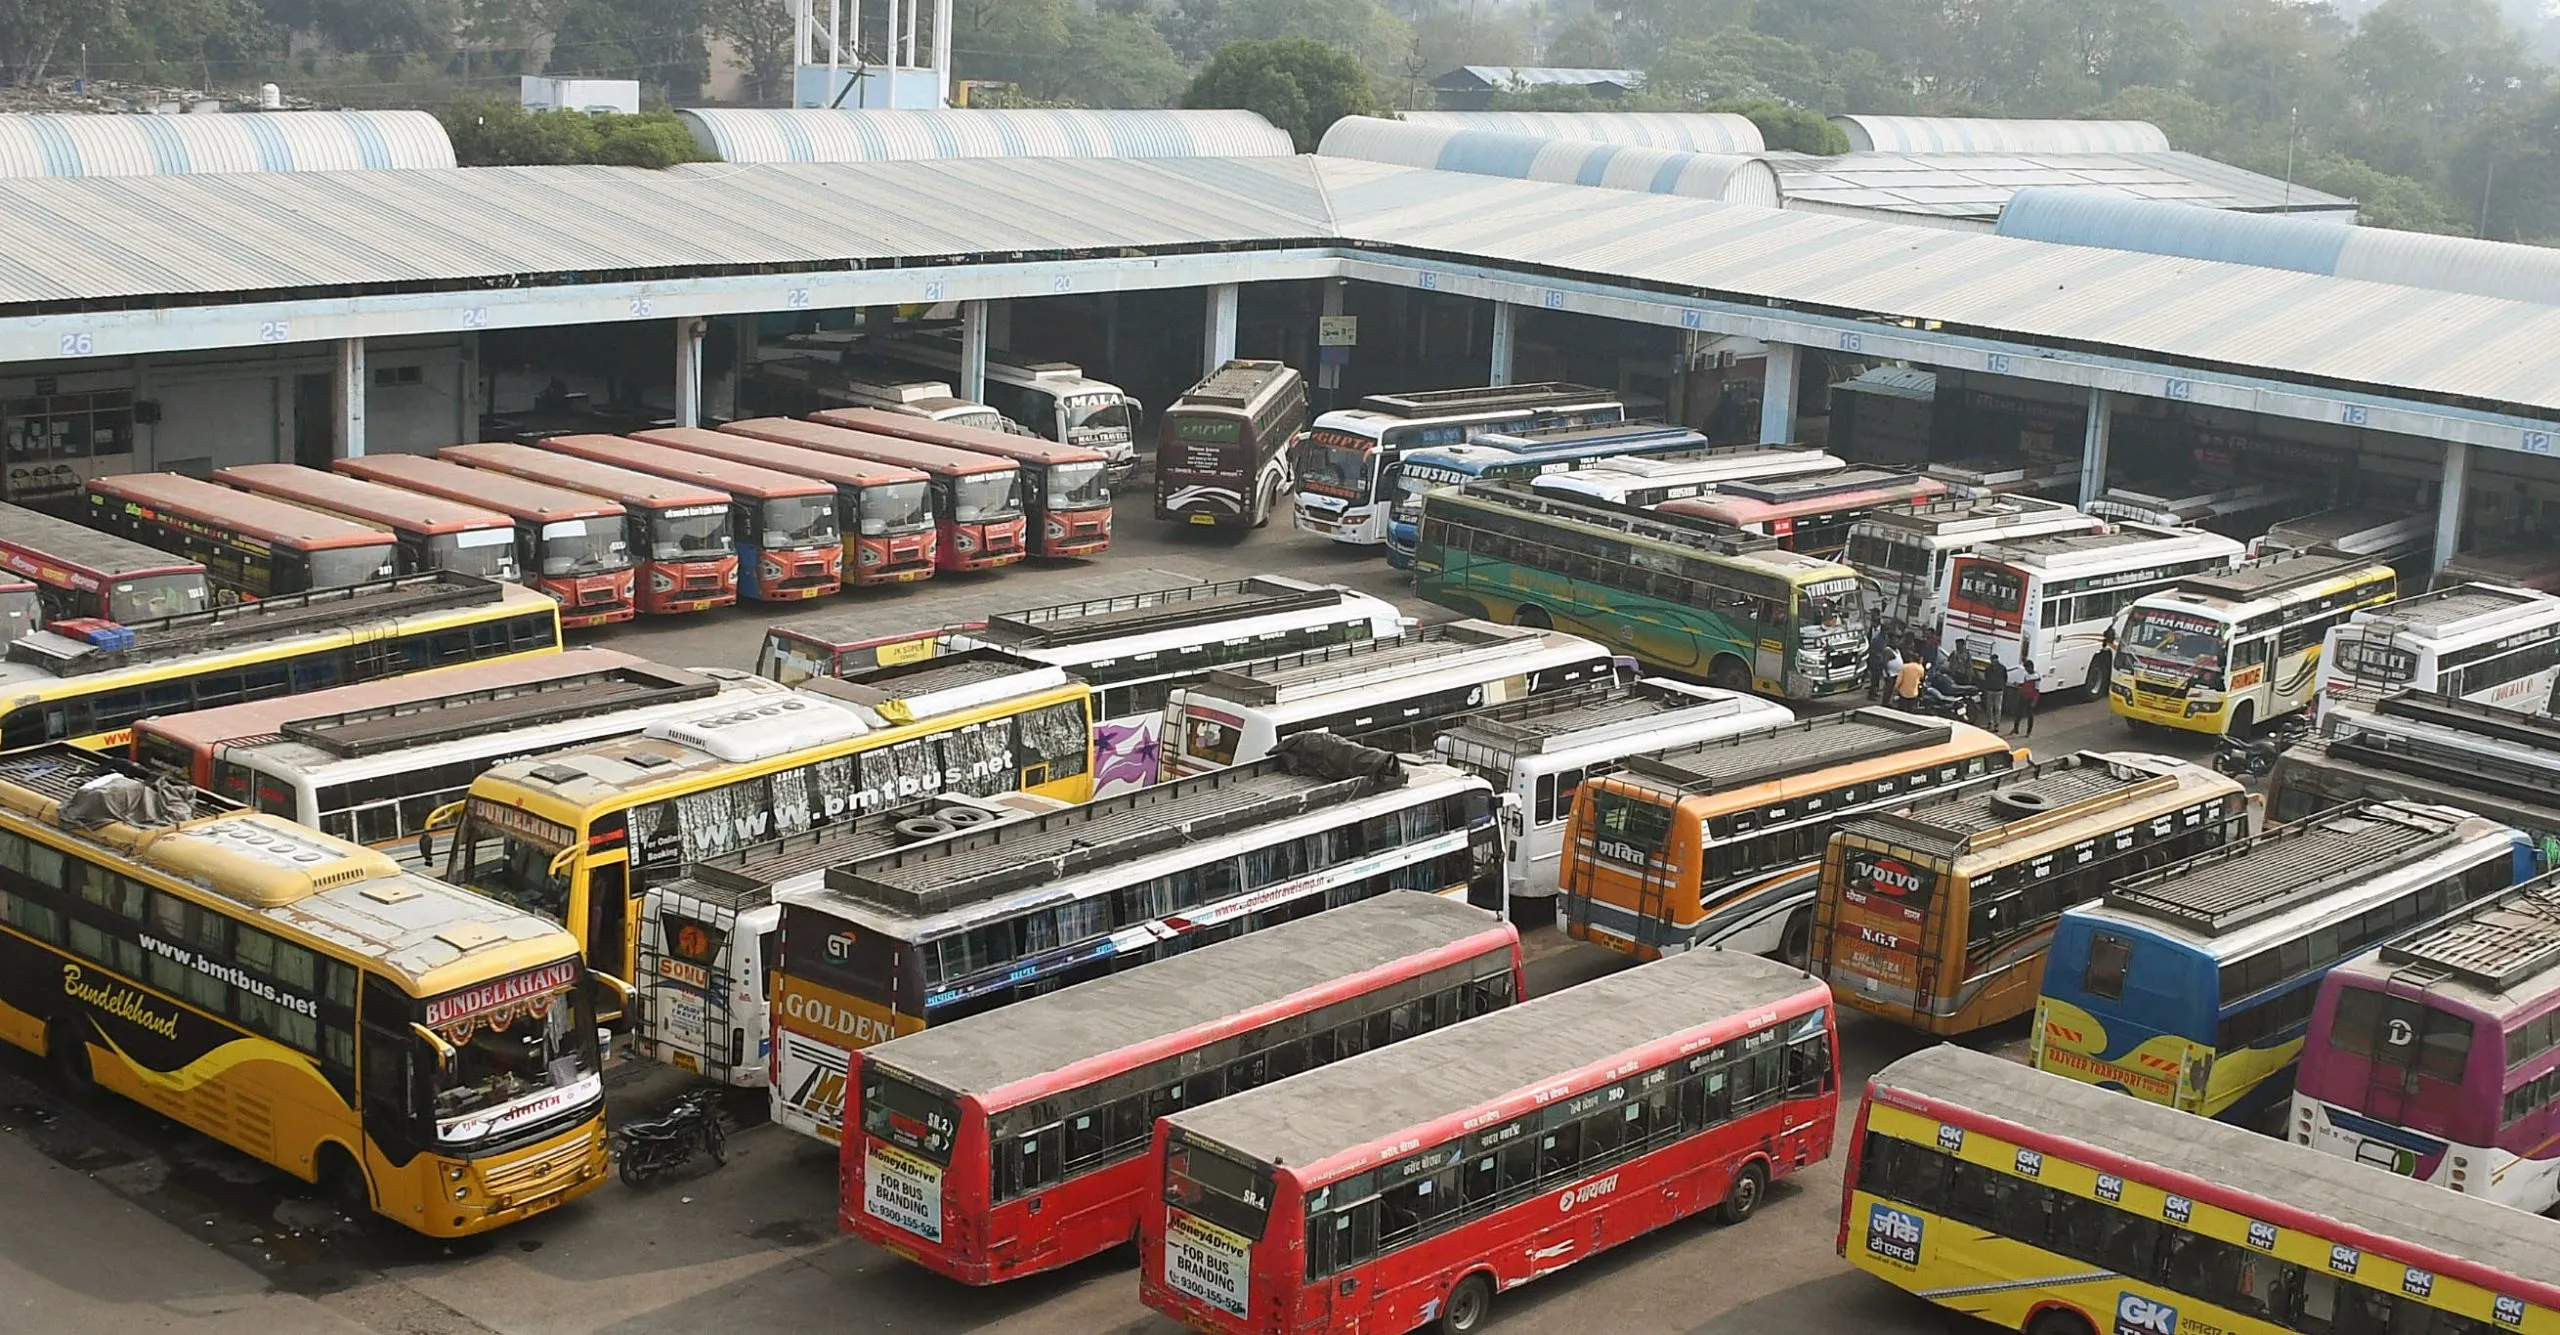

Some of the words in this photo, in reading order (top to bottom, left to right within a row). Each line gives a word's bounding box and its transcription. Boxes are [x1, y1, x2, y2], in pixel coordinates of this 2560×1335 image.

[1054, 275, 1073, 292] 20
[1418, 272, 1436, 288] 19
[789, 288, 809, 307] 22
[926, 281, 944, 299] 21
[1546, 290, 1563, 307] 18
[464, 307, 487, 326] 24
[630, 299, 652, 317] 23
[1681, 309, 1699, 327] 17
[261, 321, 289, 340] 25
[62, 334, 92, 354] 26
[1840, 332, 1860, 350] 16
[1988, 353, 2009, 372] 15
[2166, 379, 2188, 397] 14
[1071, 393, 1121, 408] MALA
[2343, 405, 2366, 424] 13
[1317, 433, 1374, 451] GUPTA
[2523, 433, 2549, 451] 12
[1961, 577, 2018, 599] KHATI
[694, 748, 1013, 851] www.bmtbus.net
[647, 846, 679, 861] Booking
[1855, 861, 1920, 892] VOLVO
[827, 934, 852, 959] GT
[1861, 927, 1898, 948] N.G.T
[139, 933, 318, 1019] www.bmtbus.net
[659, 958, 706, 985] SONU
[63, 964, 178, 1040] Bundelkhand
[426, 961, 575, 1026] BUNDELKHAND
[787, 993, 891, 1043] GOLDEN
[2049, 1049, 2088, 1071] RAJVEER
[2090, 1062, 2142, 1088] TRANSPORT
[503, 1094, 561, 1122] सीताराम
[1939, 1125, 1962, 1141] GK
[1939, 1139, 1961, 1151] TMT
[868, 1146, 936, 1185] Money4Drive
[2016, 1151, 2041, 1167] GK
[2016, 1164, 2038, 1176] TMT
[880, 1173, 900, 1190] FOR
[902, 1182, 923, 1201] BUS
[1576, 1173, 1619, 1203] मायबस
[2097, 1175, 2121, 1192] GK
[876, 1185, 929, 1218] BRANDING
[1243, 1189, 1265, 1209] SR-4
[2096, 1188, 2118, 1201] TMT
[2165, 1196, 2190, 1214] GK
[2165, 1209, 2187, 1222] TMT
[1873, 1211, 1920, 1244] जीके
[2250, 1222, 2275, 1240] GK
[1170, 1217, 1245, 1258] Money4Drive
[2249, 1236, 2272, 1249] TMT
[1183, 1244, 1204, 1264] FOR
[1206, 1255, 1230, 1276] BUS
[2332, 1247, 2358, 1265] GK
[1177, 1256, 1235, 1294] BRANDING
[2331, 1261, 2355, 1273] TMT
[2405, 1268, 2432, 1287] GK
[2404, 1283, 2429, 1296] TMT
[2120, 1296, 2173, 1331] GK
[2496, 1297, 2523, 1316] GK
[2495, 1312, 2520, 1325] TMT
